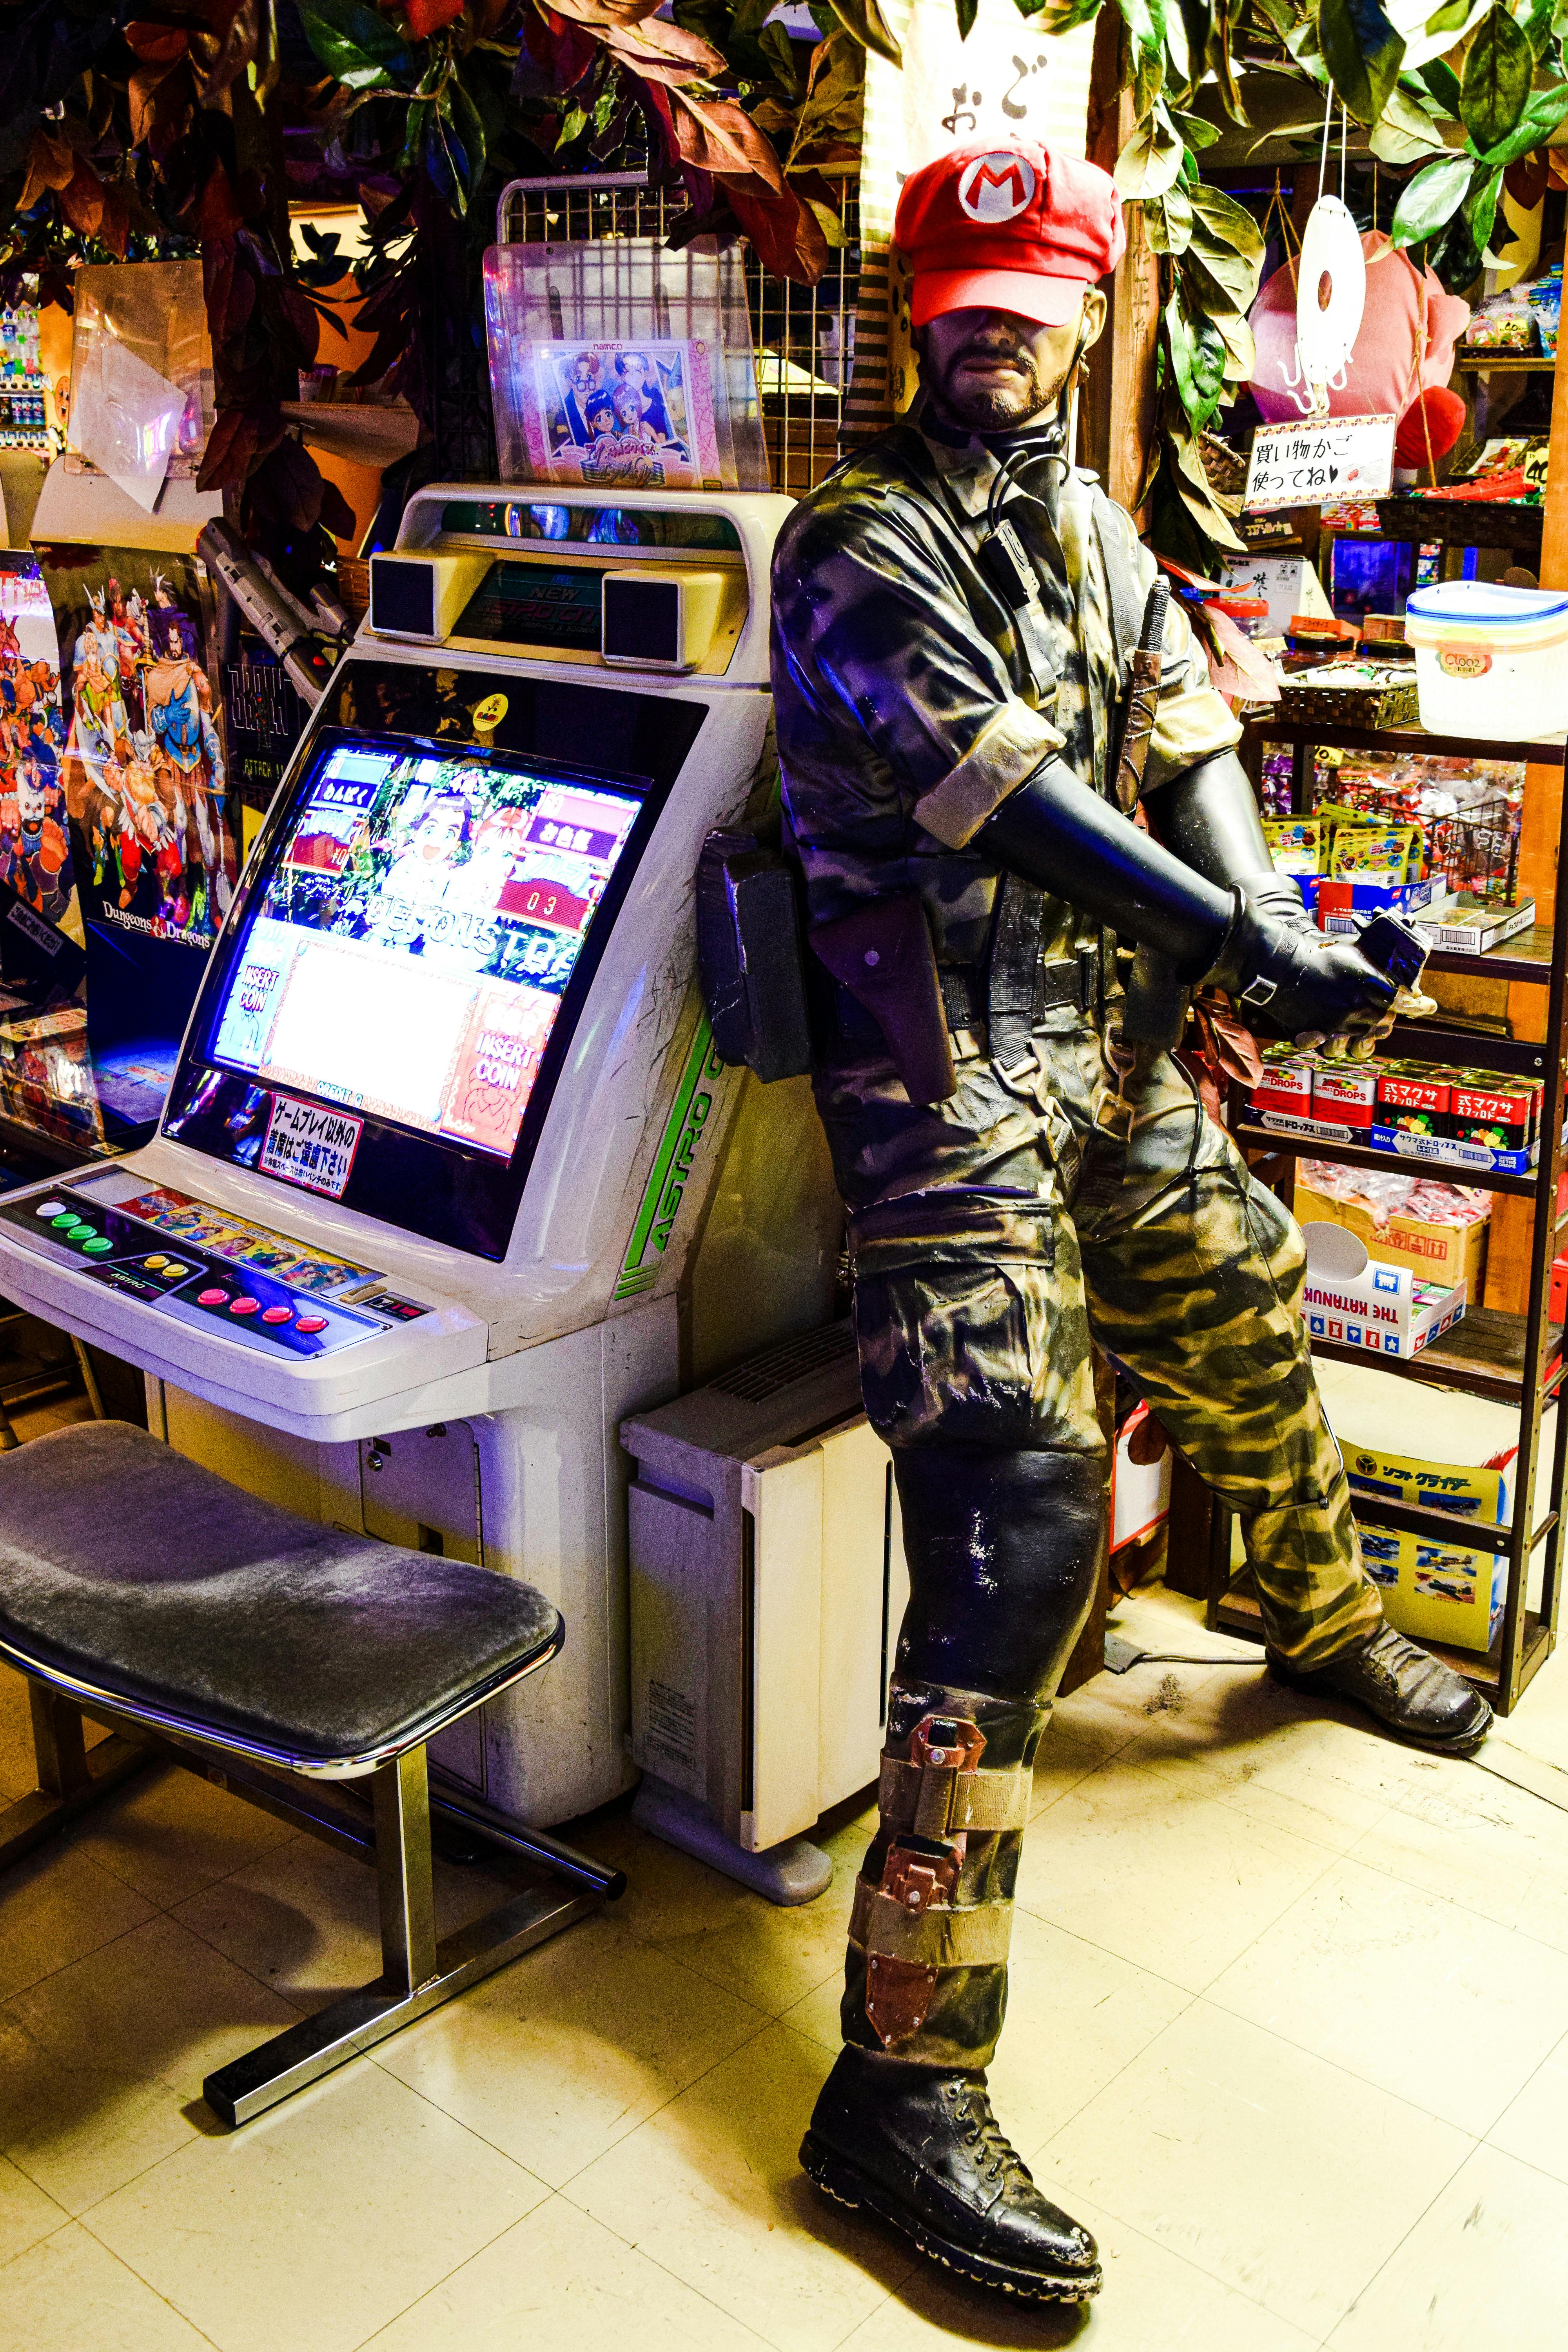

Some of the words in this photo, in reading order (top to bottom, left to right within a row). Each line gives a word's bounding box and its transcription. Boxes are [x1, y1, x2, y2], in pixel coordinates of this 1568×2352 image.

[965, 163, 1026, 209] M
[1257, 435, 1352, 465] 買い物かご
[1252, 466, 1326, 492] 使ってね
[529, 586, 581, 602] NEW
[559, 606, 602, 624] CIT
[103, 901, 152, 931] Dungeons
[165, 920, 210, 949] Dragons
[241, 965, 279, 991] INSERT
[239, 988, 268, 1012] COIN
[475, 1032, 535, 1069] INSERT
[476, 1058, 521, 1092] COIN
[1270, 1079, 1303, 1090] DROPS
[316, 1081, 352, 1103] CREDIT
[1332, 1089, 1366, 1101] DROPS
[274, 1101, 355, 1149] ゲームプレイ以外の
[267, 1129, 347, 1176] 着席はご遠慮下さい
[1400, 1134, 1457, 1150] サクマ式ドロップス
[650, 1091, 712, 1254] ASTRO
[111, 1273, 146, 1289] ASTRO
[1302, 1287, 1368, 1317] KATANUK
[1373, 1289, 1399, 1324] THE
